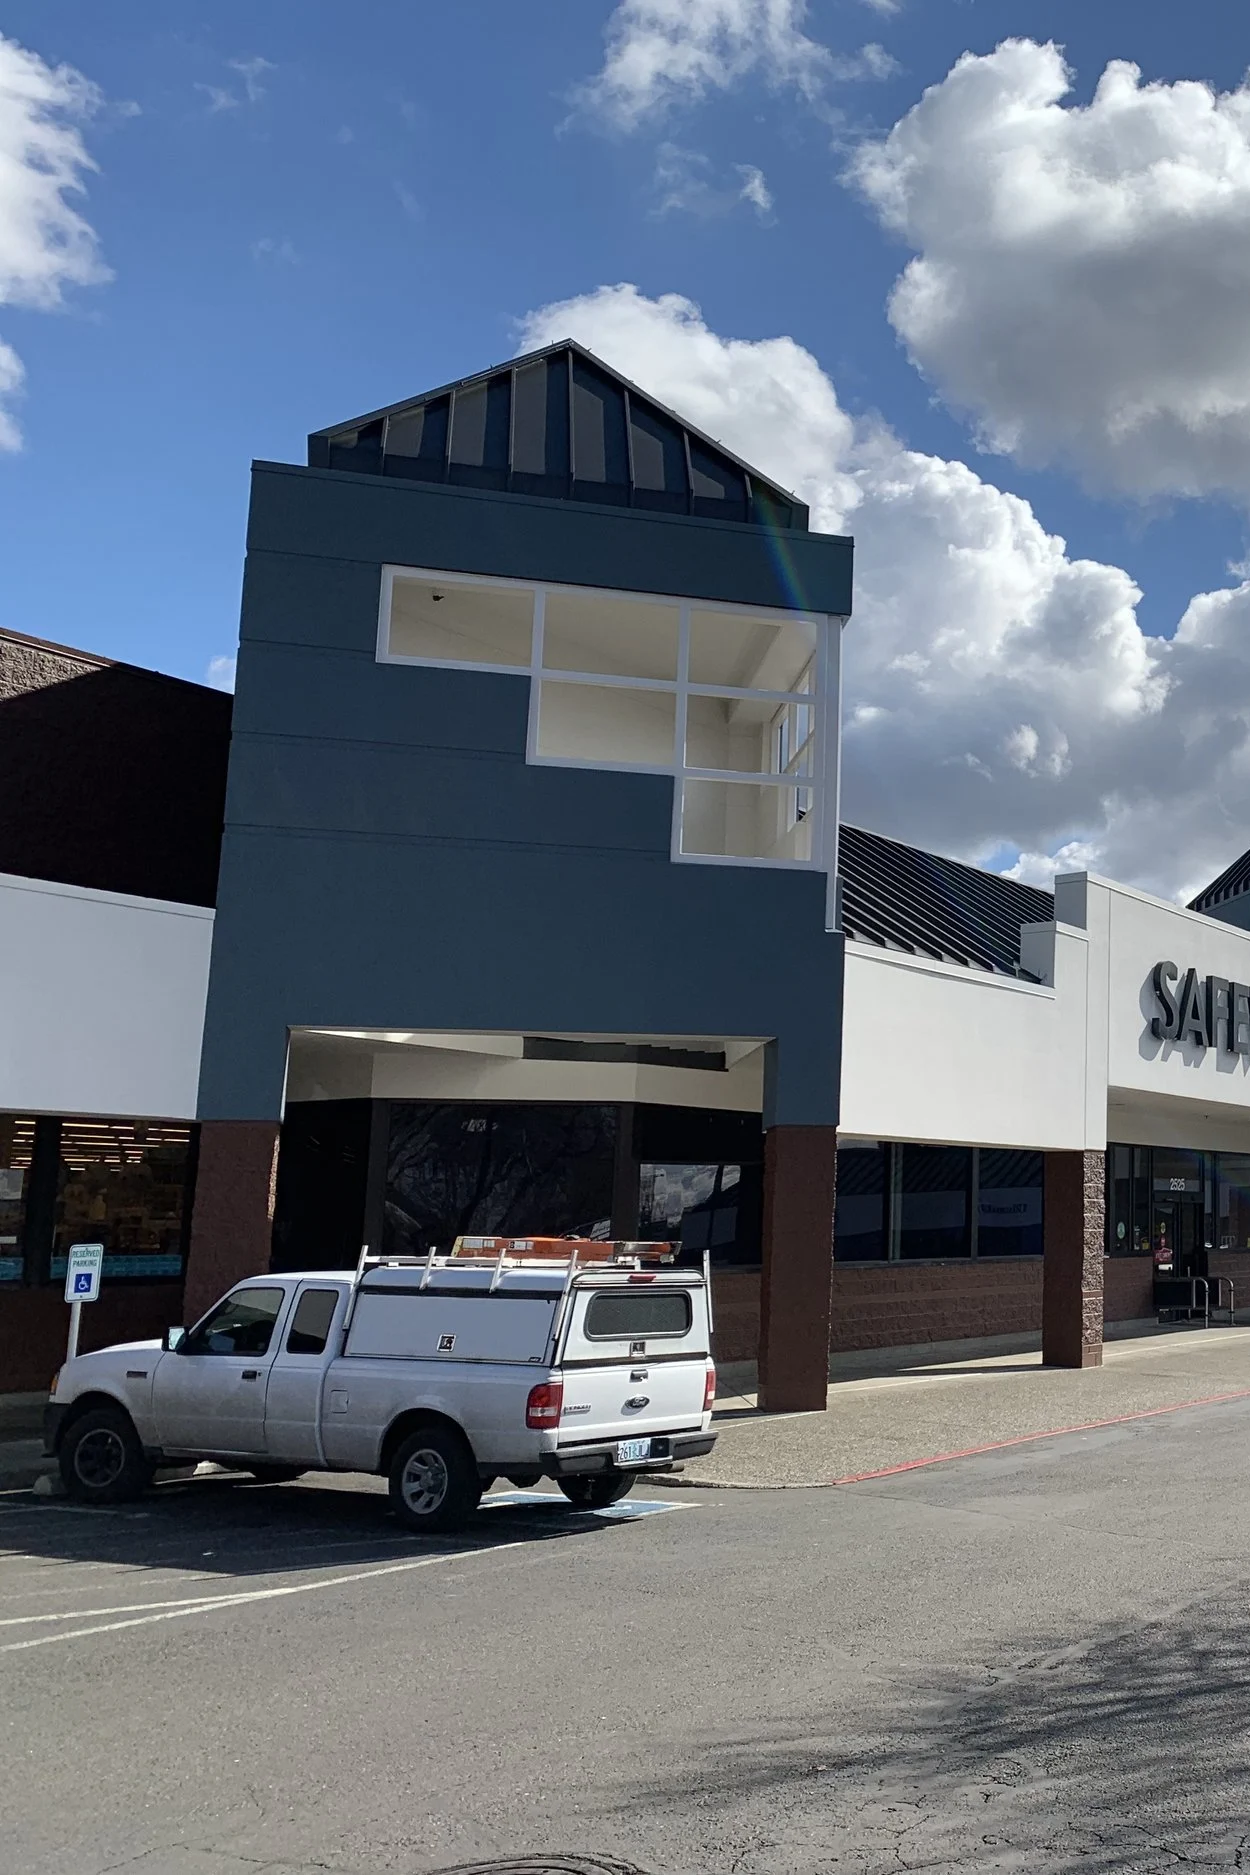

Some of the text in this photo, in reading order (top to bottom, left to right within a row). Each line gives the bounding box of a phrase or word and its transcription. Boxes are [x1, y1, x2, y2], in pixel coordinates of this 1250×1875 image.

[1169, 1178, 1185, 1190] 2525
[72, 1250, 99, 1258] RESERVED
[73, 1259, 97, 1267] PARKING
